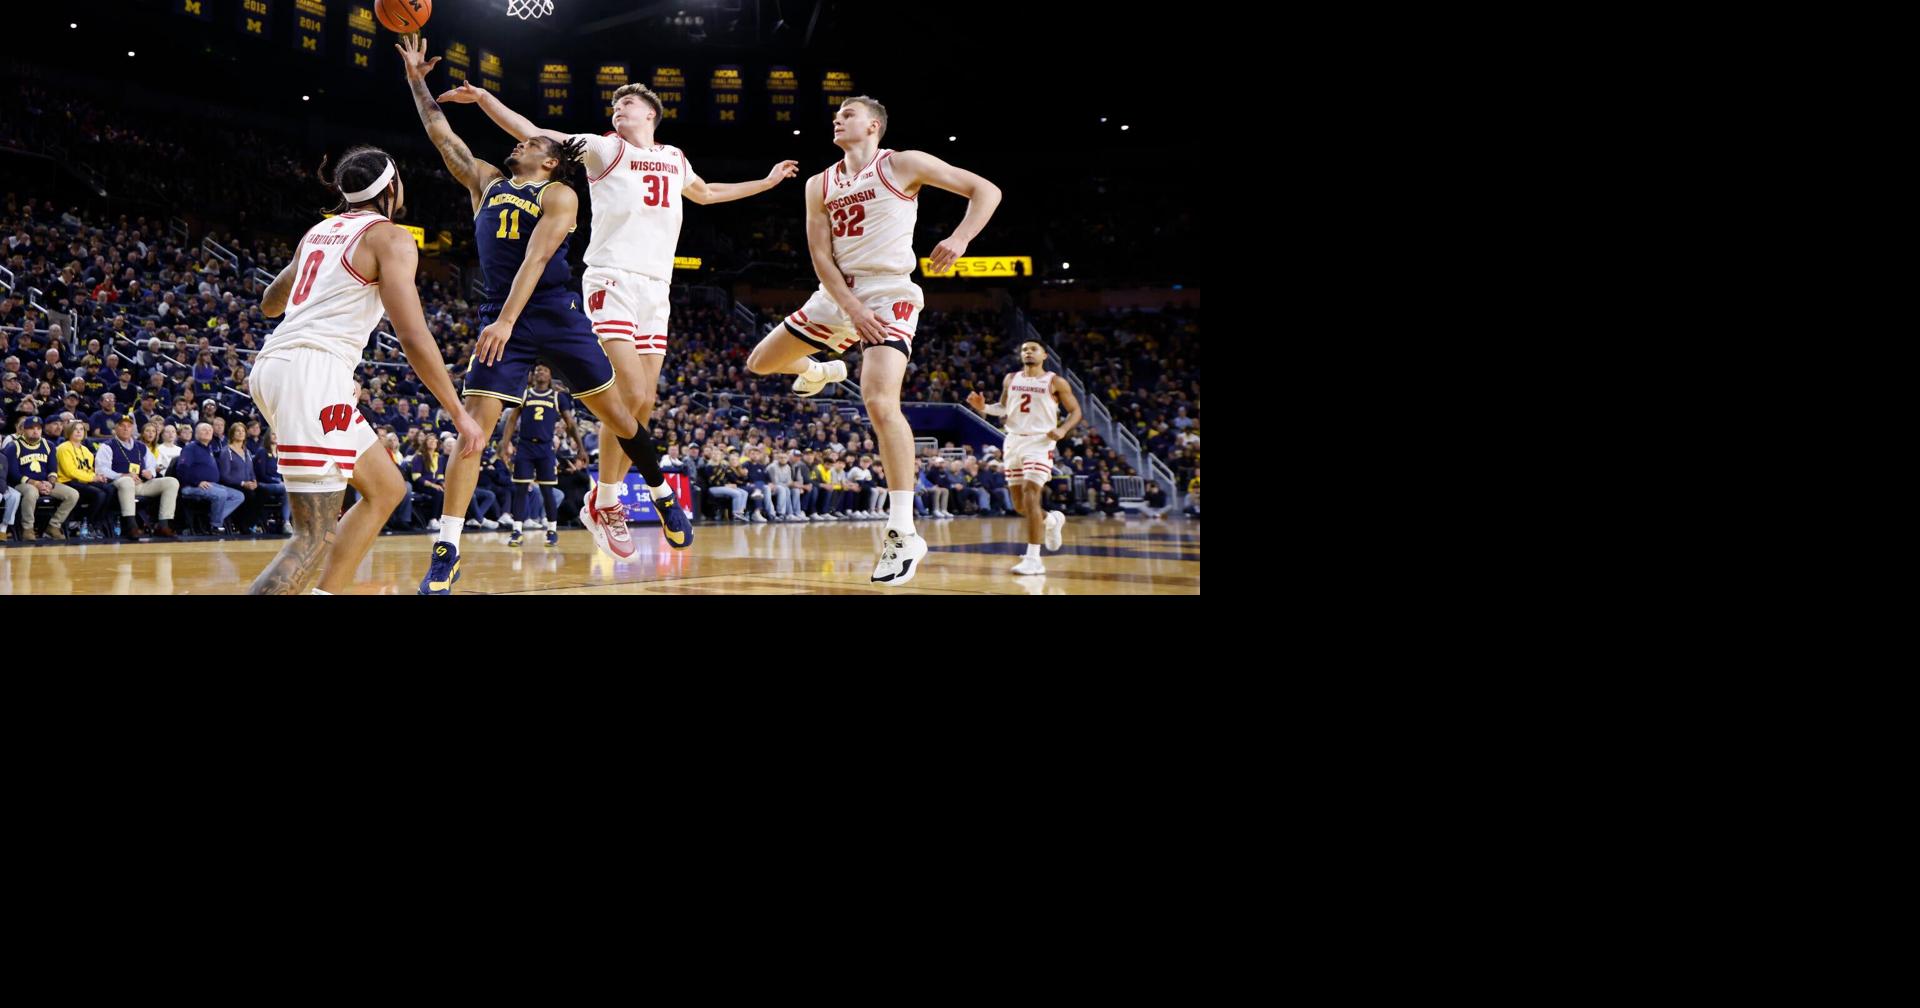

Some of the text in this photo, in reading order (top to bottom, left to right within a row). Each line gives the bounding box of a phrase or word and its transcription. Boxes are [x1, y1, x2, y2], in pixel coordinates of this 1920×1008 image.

[246, 17, 263, 34] M
[299, 16, 321, 33] 2014
[302, 35, 318, 51] M
[352, 33, 373, 49] 2017
[630, 160, 679, 175] WISCONSIN
[642, 174, 670, 208] 31
[826, 188, 876, 212] WISCONSIN
[488, 193, 541, 218] MICHIGAN
[496, 208, 520, 239] 11
[832, 203, 865, 237] 32
[292, 249, 325, 306] 0
[588, 289, 607, 315] W
[892, 301, 914, 321] W
[1011, 385, 1046, 394] WISCONSIN
[1020, 393, 1031, 413] 2
[319, 403, 353, 436] W
[534, 406, 544, 421] 2
